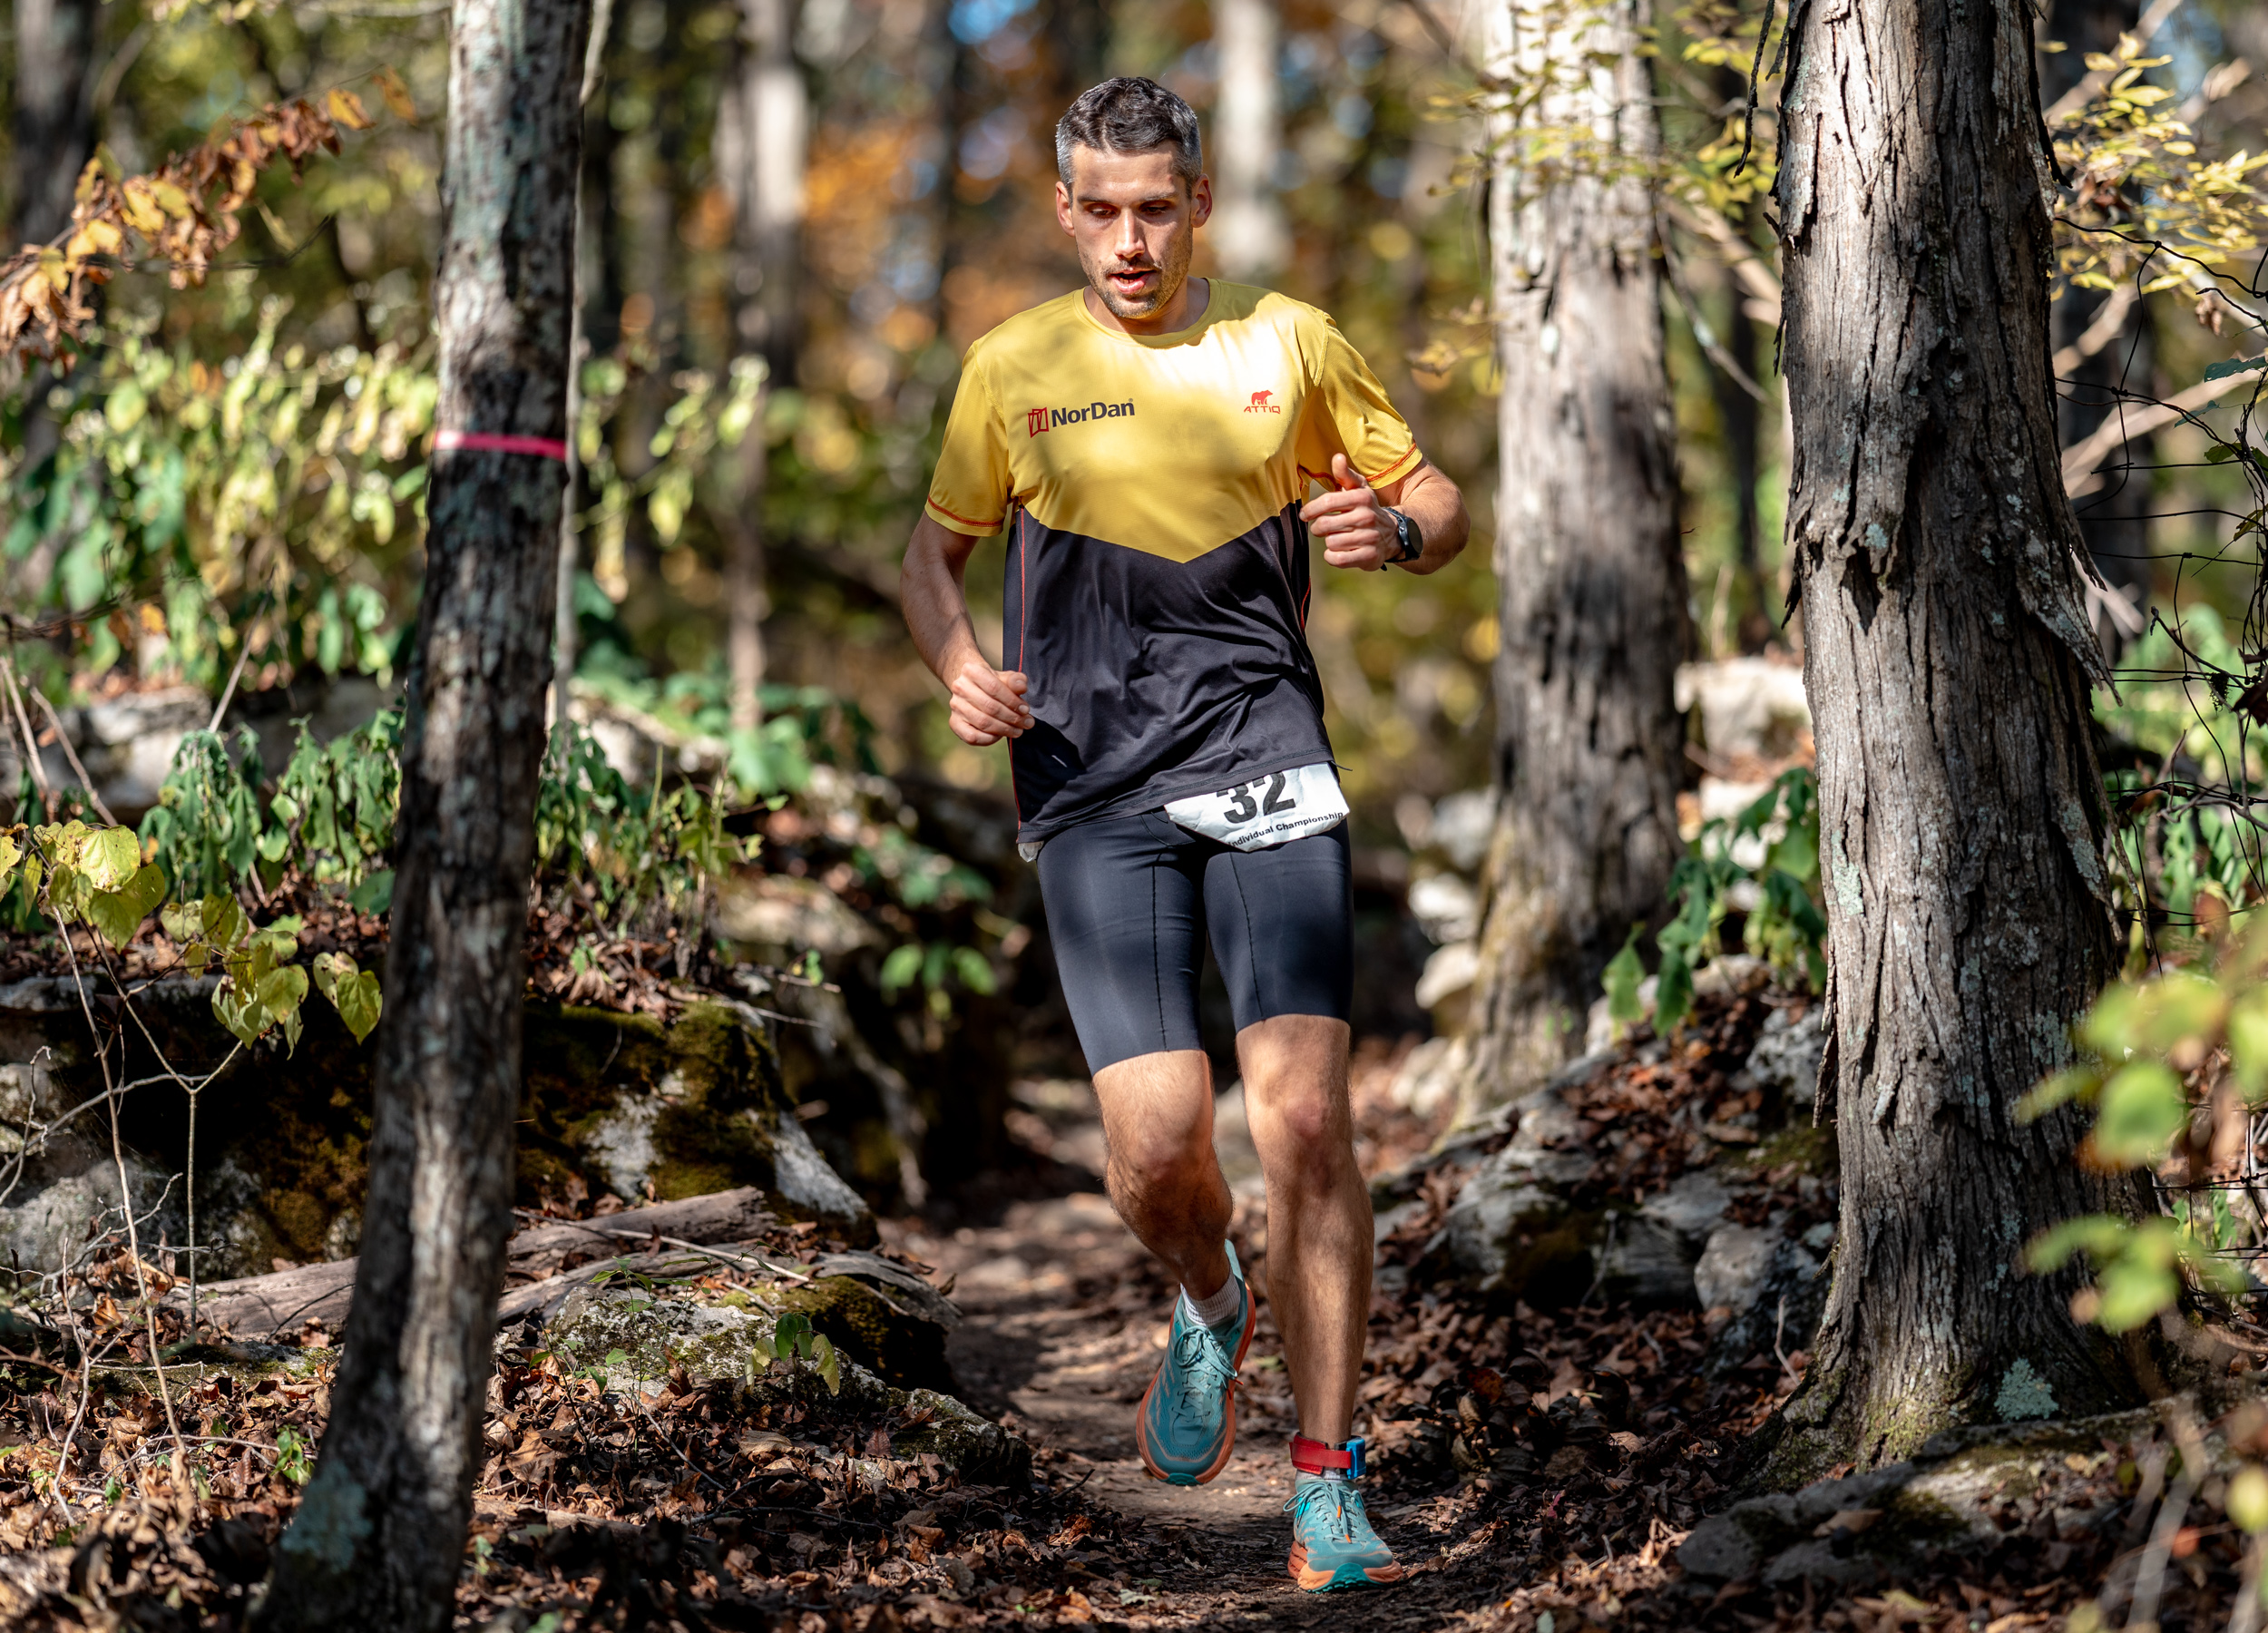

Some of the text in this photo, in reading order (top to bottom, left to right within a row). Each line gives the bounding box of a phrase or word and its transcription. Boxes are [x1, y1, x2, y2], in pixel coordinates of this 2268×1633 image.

[1051, 401, 1135, 427] NorDan
[1243, 406, 1280, 414] ATTIQ
[1216, 772, 1296, 824] 32
[1276, 812, 1344, 832] Championship
